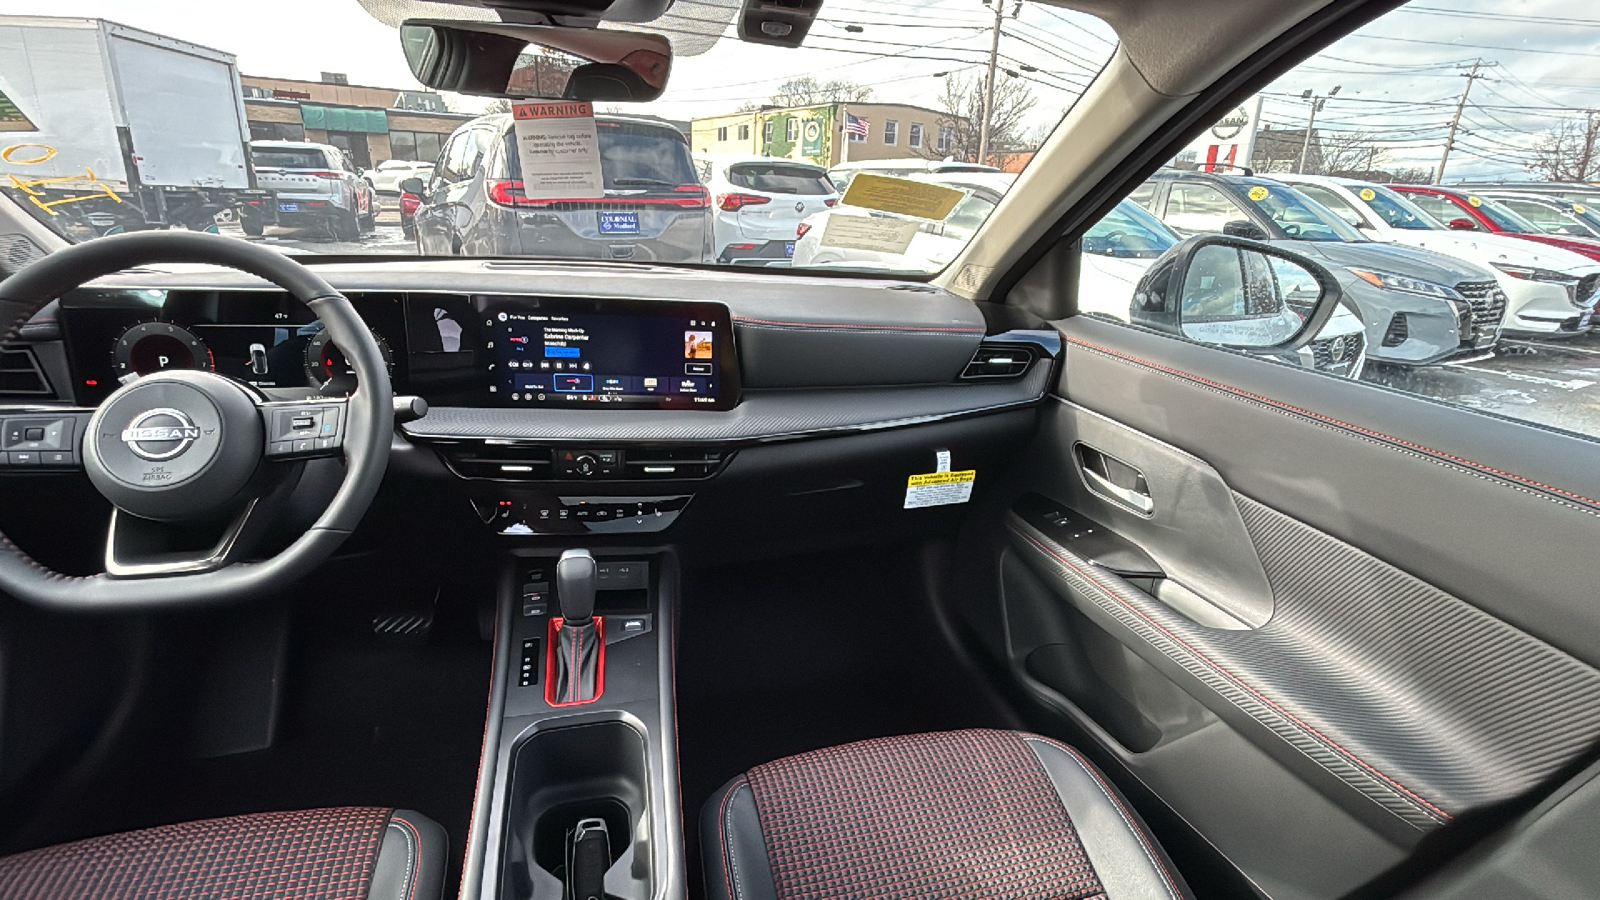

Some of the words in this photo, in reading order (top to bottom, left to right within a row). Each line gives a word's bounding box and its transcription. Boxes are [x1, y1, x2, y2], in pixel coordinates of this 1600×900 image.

[529, 104, 586, 116] WARNING
[158, 356, 169, 367] P
[124, 429, 198, 439] NISSAN
